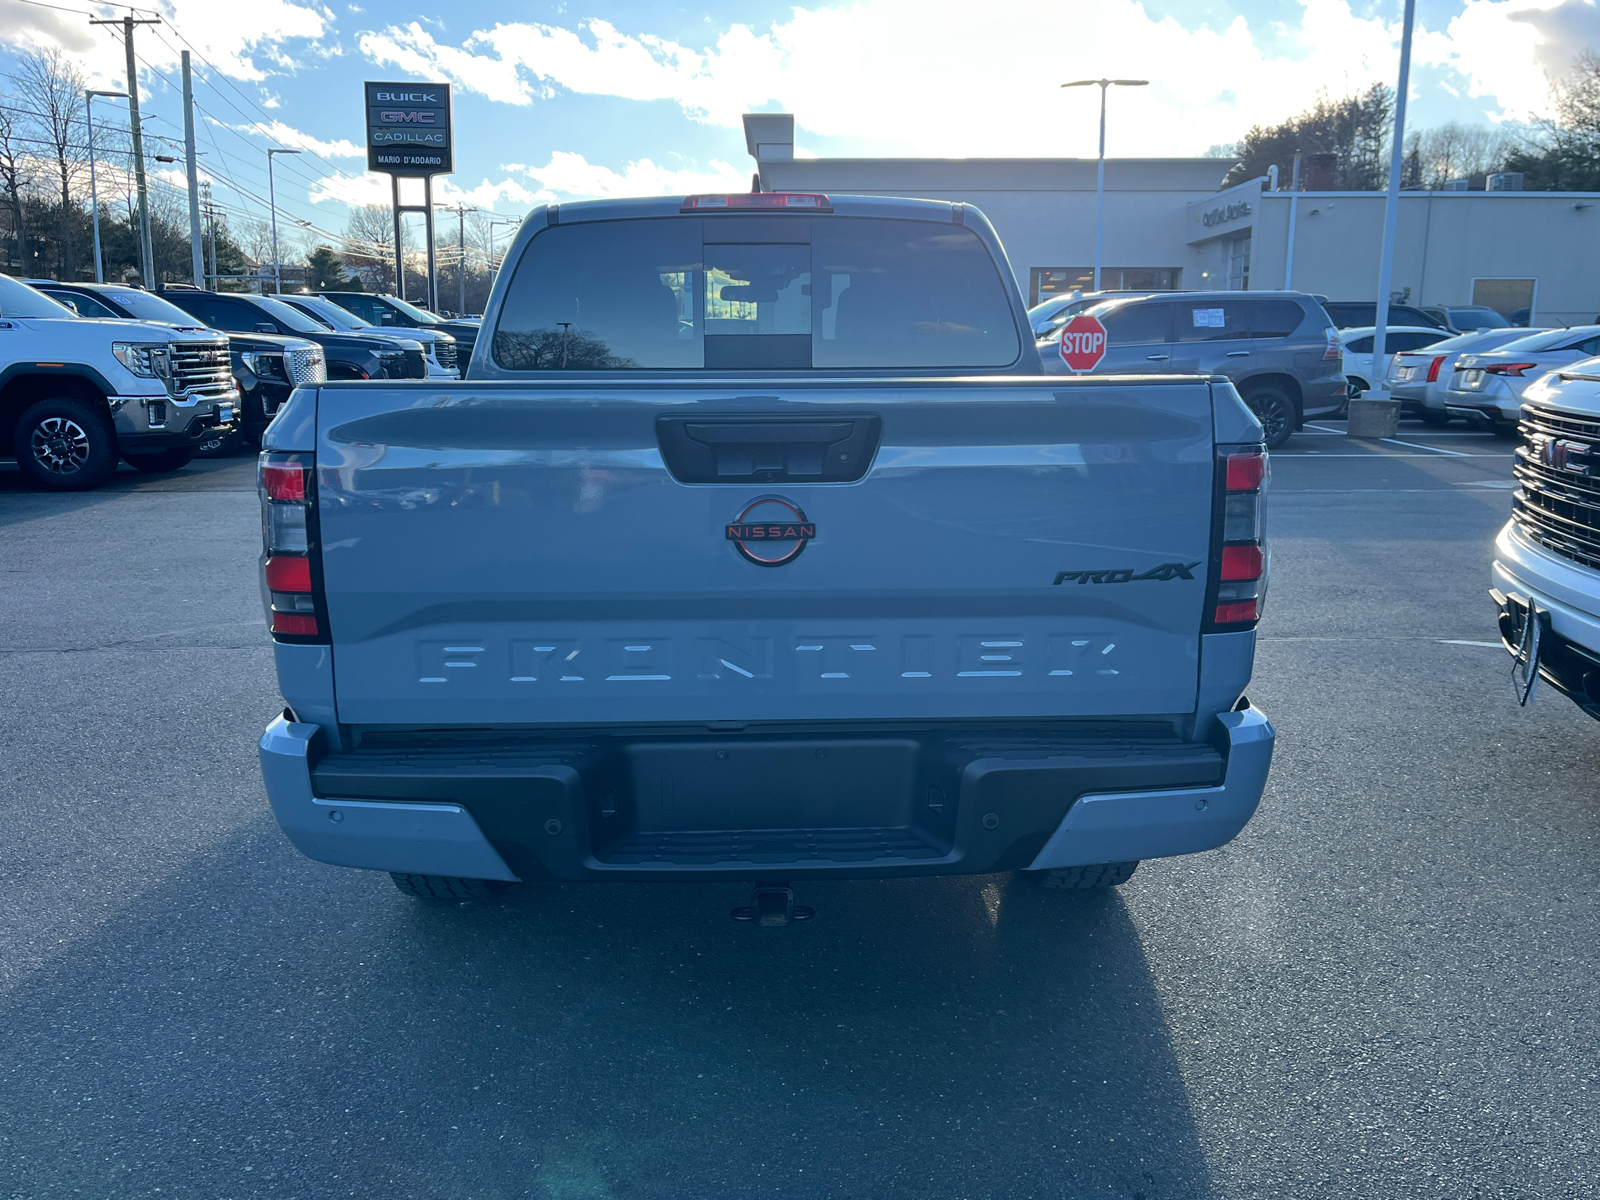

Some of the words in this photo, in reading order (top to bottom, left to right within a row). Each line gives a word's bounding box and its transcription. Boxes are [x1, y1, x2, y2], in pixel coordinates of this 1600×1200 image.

[376, 92, 437, 102] BUICK
[380, 111, 435, 124] GMC
[374, 132, 443, 142] CADILLAC
[377, 155, 400, 164] MARIO
[403, 156, 441, 165] D'ADDARIO
[1062, 332, 1104, 354] STOP
[728, 526, 813, 537] NISSAN
[415, 632, 1121, 683] FRONTIER
